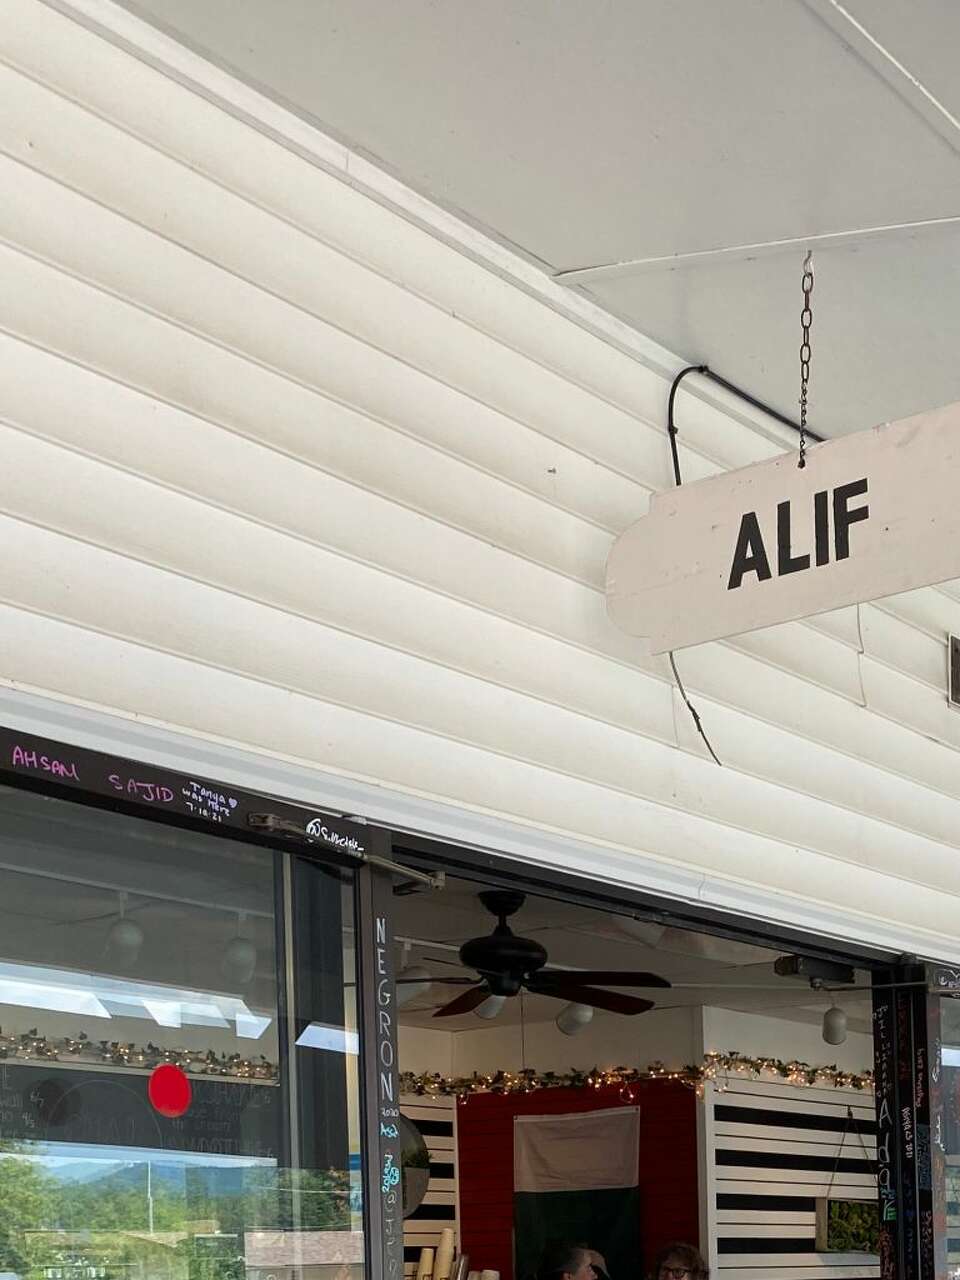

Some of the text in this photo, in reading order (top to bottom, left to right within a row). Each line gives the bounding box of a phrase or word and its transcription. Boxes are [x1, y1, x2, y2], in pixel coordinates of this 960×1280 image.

[727, 478, 869, 590] ALIF
[108, 774, 174, 802] SAJID
[376, 917, 394, 1102] NEGRON
